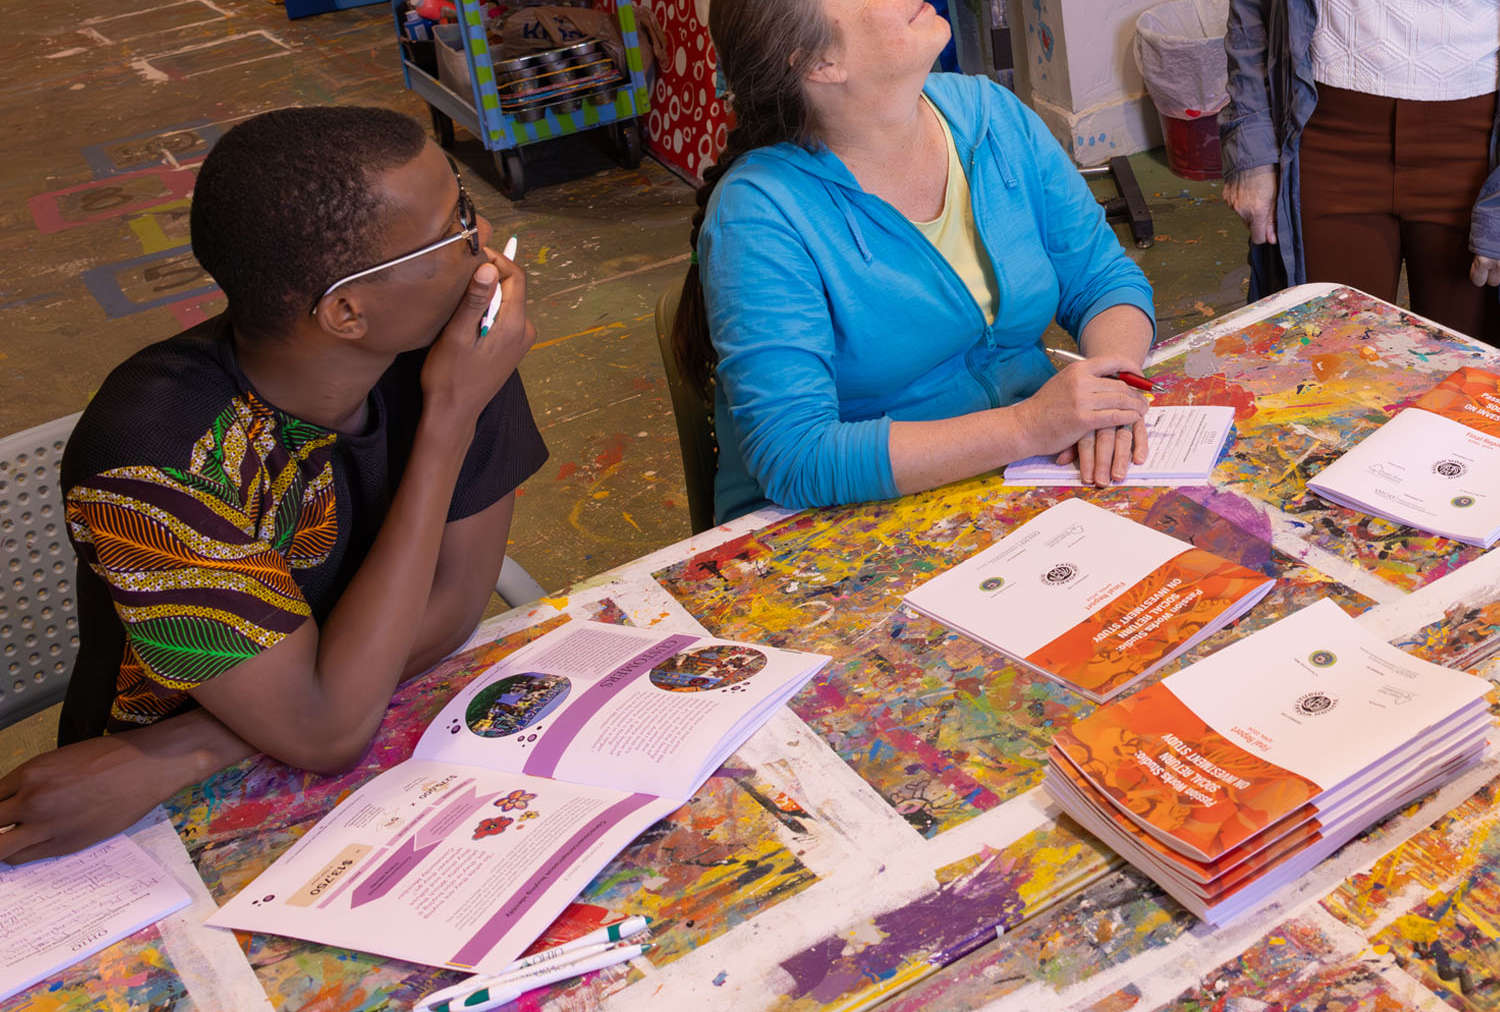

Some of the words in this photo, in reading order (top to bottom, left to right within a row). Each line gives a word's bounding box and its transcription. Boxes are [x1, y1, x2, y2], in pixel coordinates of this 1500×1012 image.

[1464, 403, 1476, 411] ON
[1465, 431, 1483, 440] Final
[1107, 581, 1125, 594] Final
[1167, 578, 1181, 588] ON
[1084, 593, 1109, 610] Report
[1120, 587, 1169, 624] INVESTMENT
[1149, 593, 1179, 613] SOCIAL
[1170, 588, 1202, 612] Passion
[1117, 614, 1151, 638] RETURN
[1144, 612, 1173, 631] Works
[1093, 623, 1120, 642] STUDY
[1115, 630, 1147, 651] Studio:
[600, 638, 679, 689] CUSTOMERS
[1230, 726, 1253, 742] Report
[1161, 733, 1191, 757] STUDY
[1251, 738, 1269, 751] Final
[1134, 750, 1163, 775] Studio:
[1159, 752, 1193, 776] RETURN
[1186, 749, 1237, 784] INVESTMENT
[1160, 771, 1186, 791] Works
[1190, 773, 1220, 792] SOCIAL
[1233, 777, 1249, 788] ON
[1184, 787, 1216, 807] Passion
[310, 858, 353, 897] $13,750
